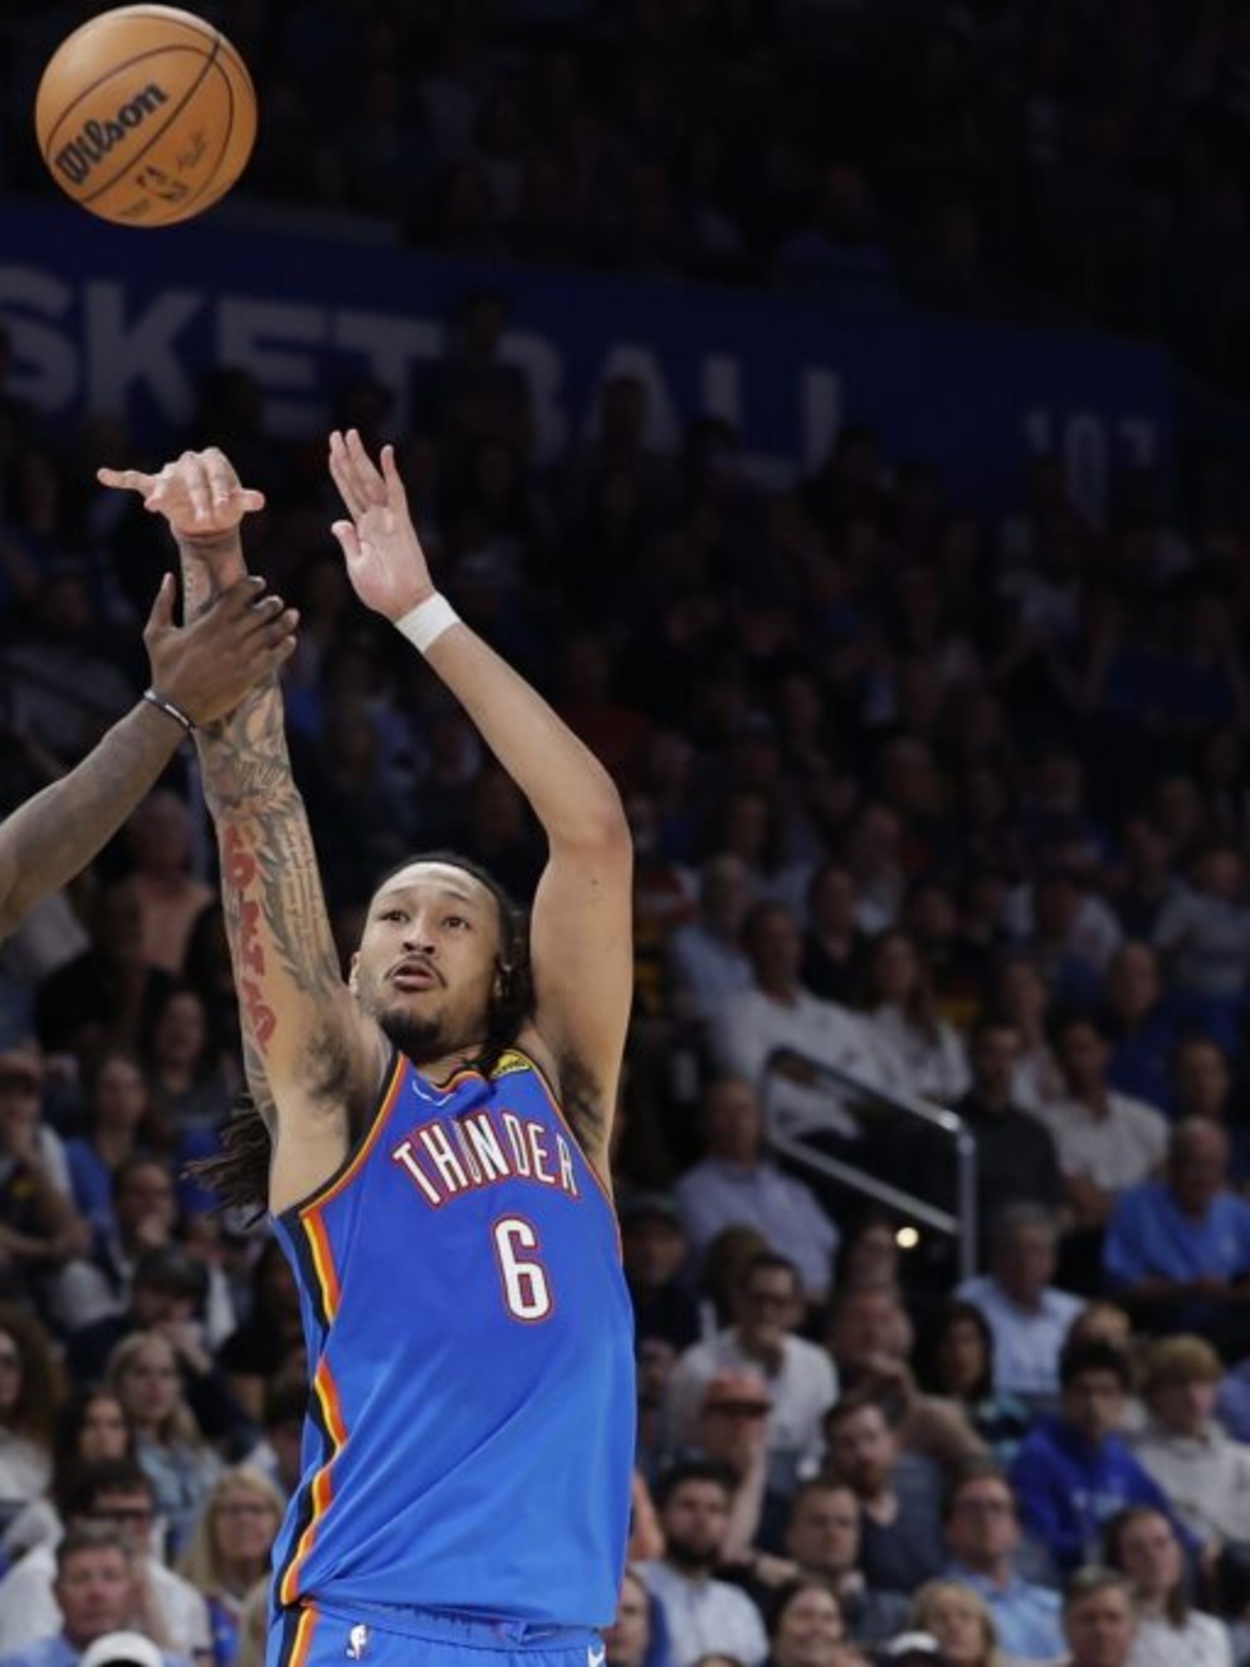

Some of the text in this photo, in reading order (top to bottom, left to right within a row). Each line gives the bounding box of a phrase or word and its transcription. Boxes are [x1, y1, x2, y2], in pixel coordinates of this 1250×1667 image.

[56, 84, 168, 184] Wilson
[391, 1111, 579, 1205] THUNDER
[493, 1216, 552, 1322] 6
